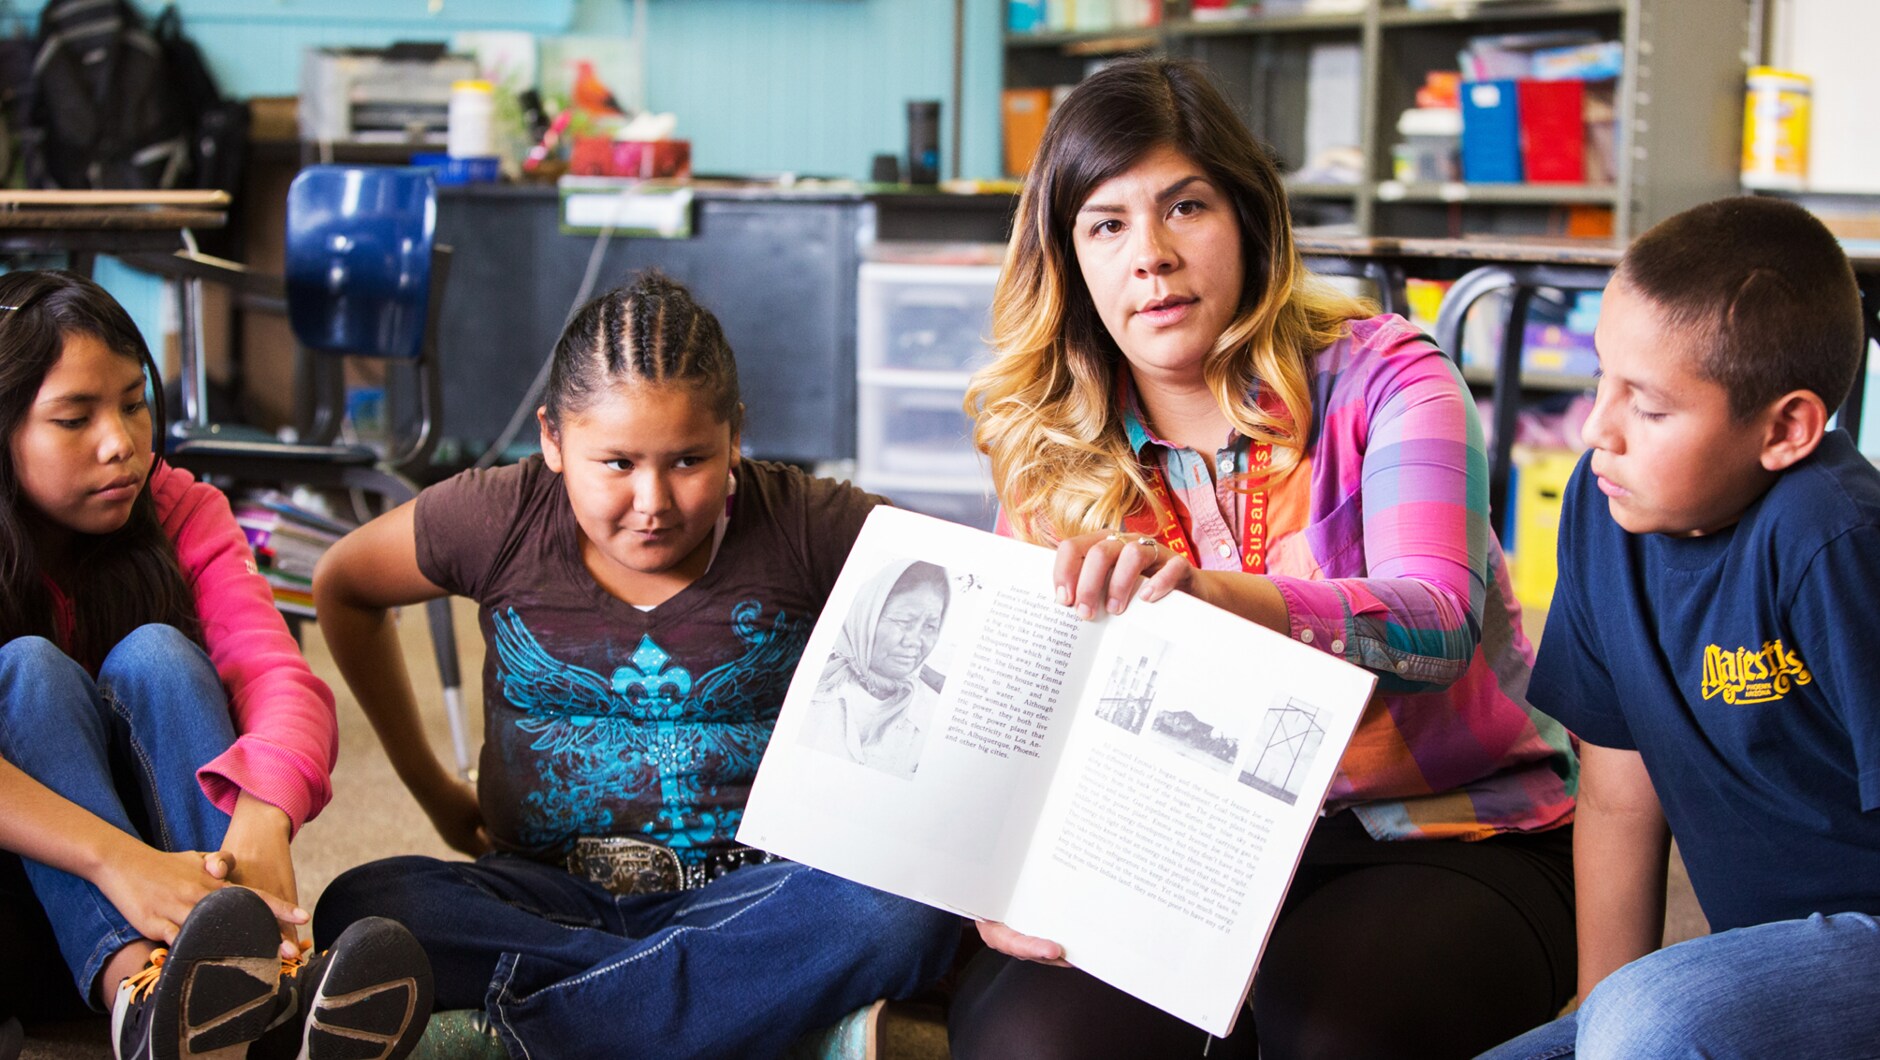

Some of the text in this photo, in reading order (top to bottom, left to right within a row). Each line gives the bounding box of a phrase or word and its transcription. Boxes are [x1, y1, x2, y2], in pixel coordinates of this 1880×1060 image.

[1245, 491, 1264, 567] Susan
[1003, 622, 1015, 632] city
[1017, 625, 1029, 634] like
[1034, 623, 1052, 631] never
[1052, 626, 1068, 636] been
[1011, 635, 1028, 643] never
[1050, 646, 1071, 657] visited
[994, 647, 1013, 659] hours
[1015, 656, 1032, 667] away
[1035, 660, 1051, 671] from
[1022, 648, 1043, 658] which
[1054, 658, 1068, 668] only
[982, 664, 1013, 679] two-room
[1014, 674, 1033, 685] house
[1035, 682, 1050, 690] with
[1007, 661, 1022, 672] lives
[1023, 669, 1038, 677] near
[1040, 672, 1062, 684] Emma
[1702, 639, 1812, 704] Majestis
[957, 697, 968, 705] tric
[998, 709, 1013, 721] they
[1016, 714, 1033, 725] both
[1036, 720, 1047, 729] live
[960, 689, 982, 700] neither
[984, 697, 1008, 707] woman
[1035, 711, 1050, 720] elec-
[1023, 696, 1054, 712] Although
[951, 713, 968, 725] feeds
[970, 720, 1002, 737] electricity
[985, 717, 1006, 727] power
[1009, 723, 1028, 733] plant
[1031, 729, 1045, 738] that
[958, 738, 976, 747] other
